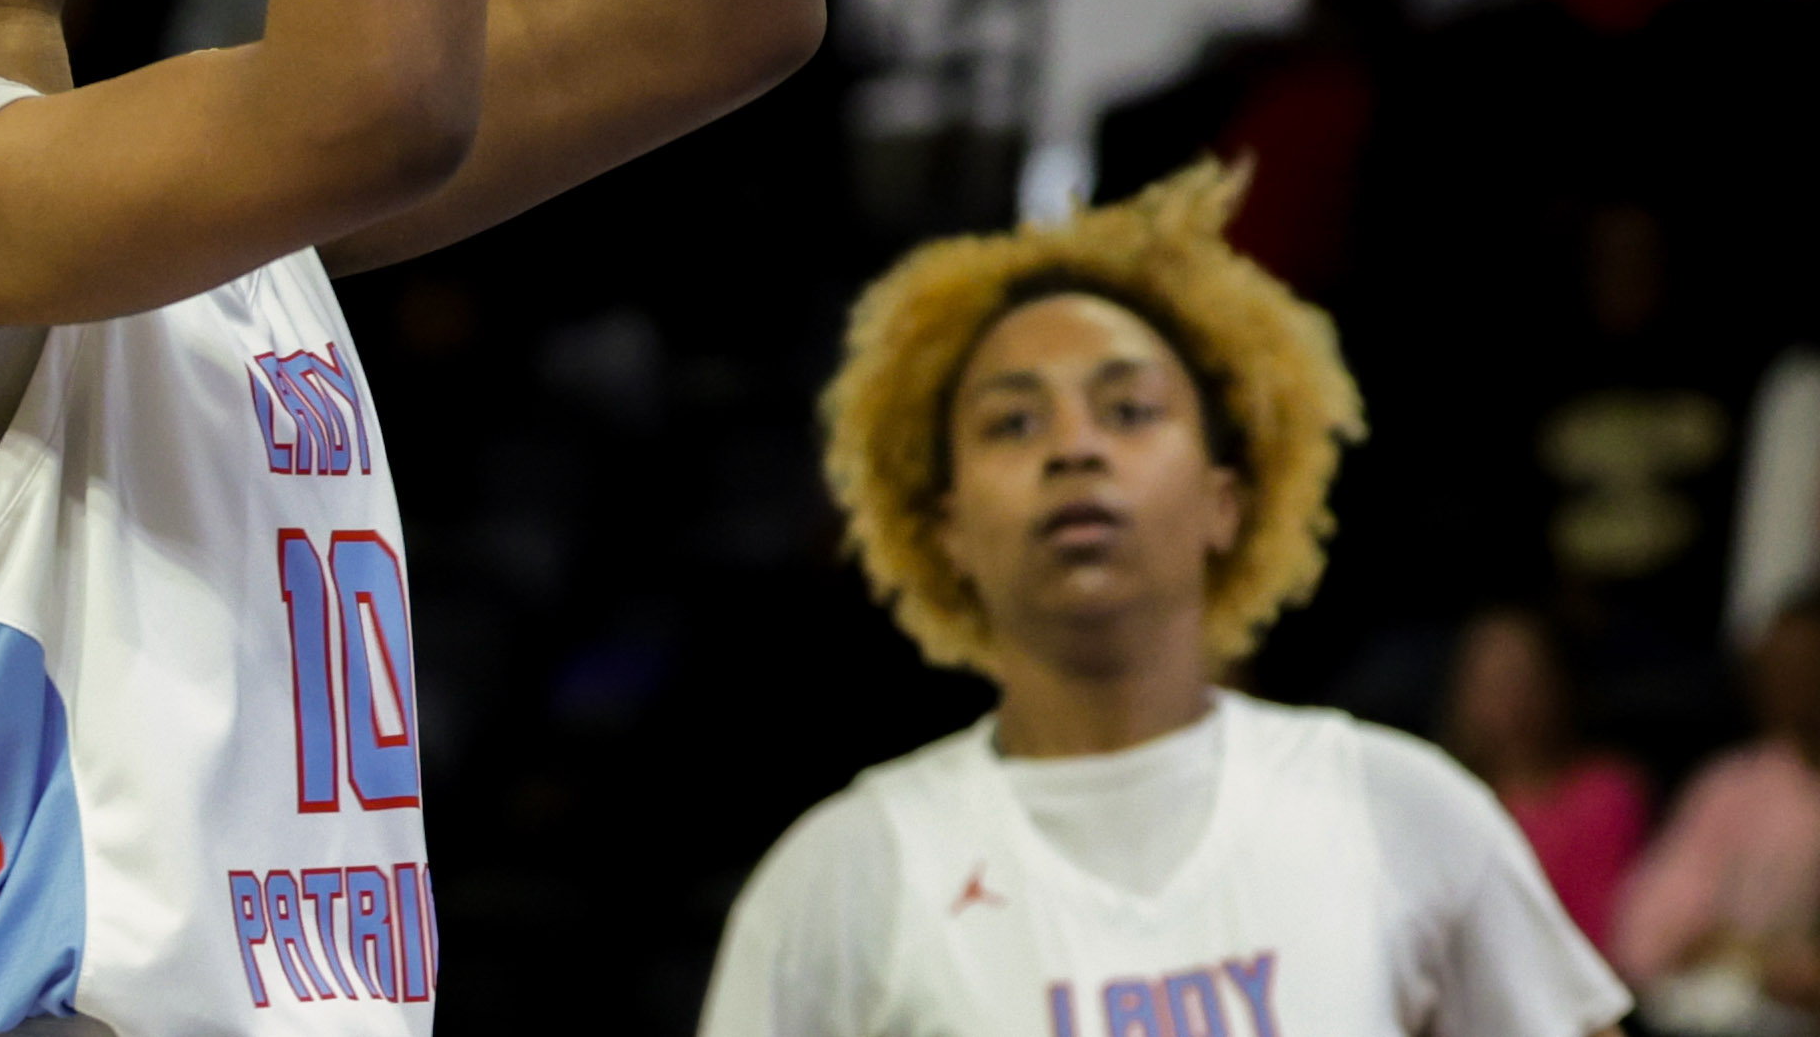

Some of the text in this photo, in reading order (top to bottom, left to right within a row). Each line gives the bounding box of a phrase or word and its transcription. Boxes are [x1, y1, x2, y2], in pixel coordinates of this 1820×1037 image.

[245, 341, 372, 476] LADY
[276, 527, 421, 813] 10
[227, 861, 440, 1008] PATRI
